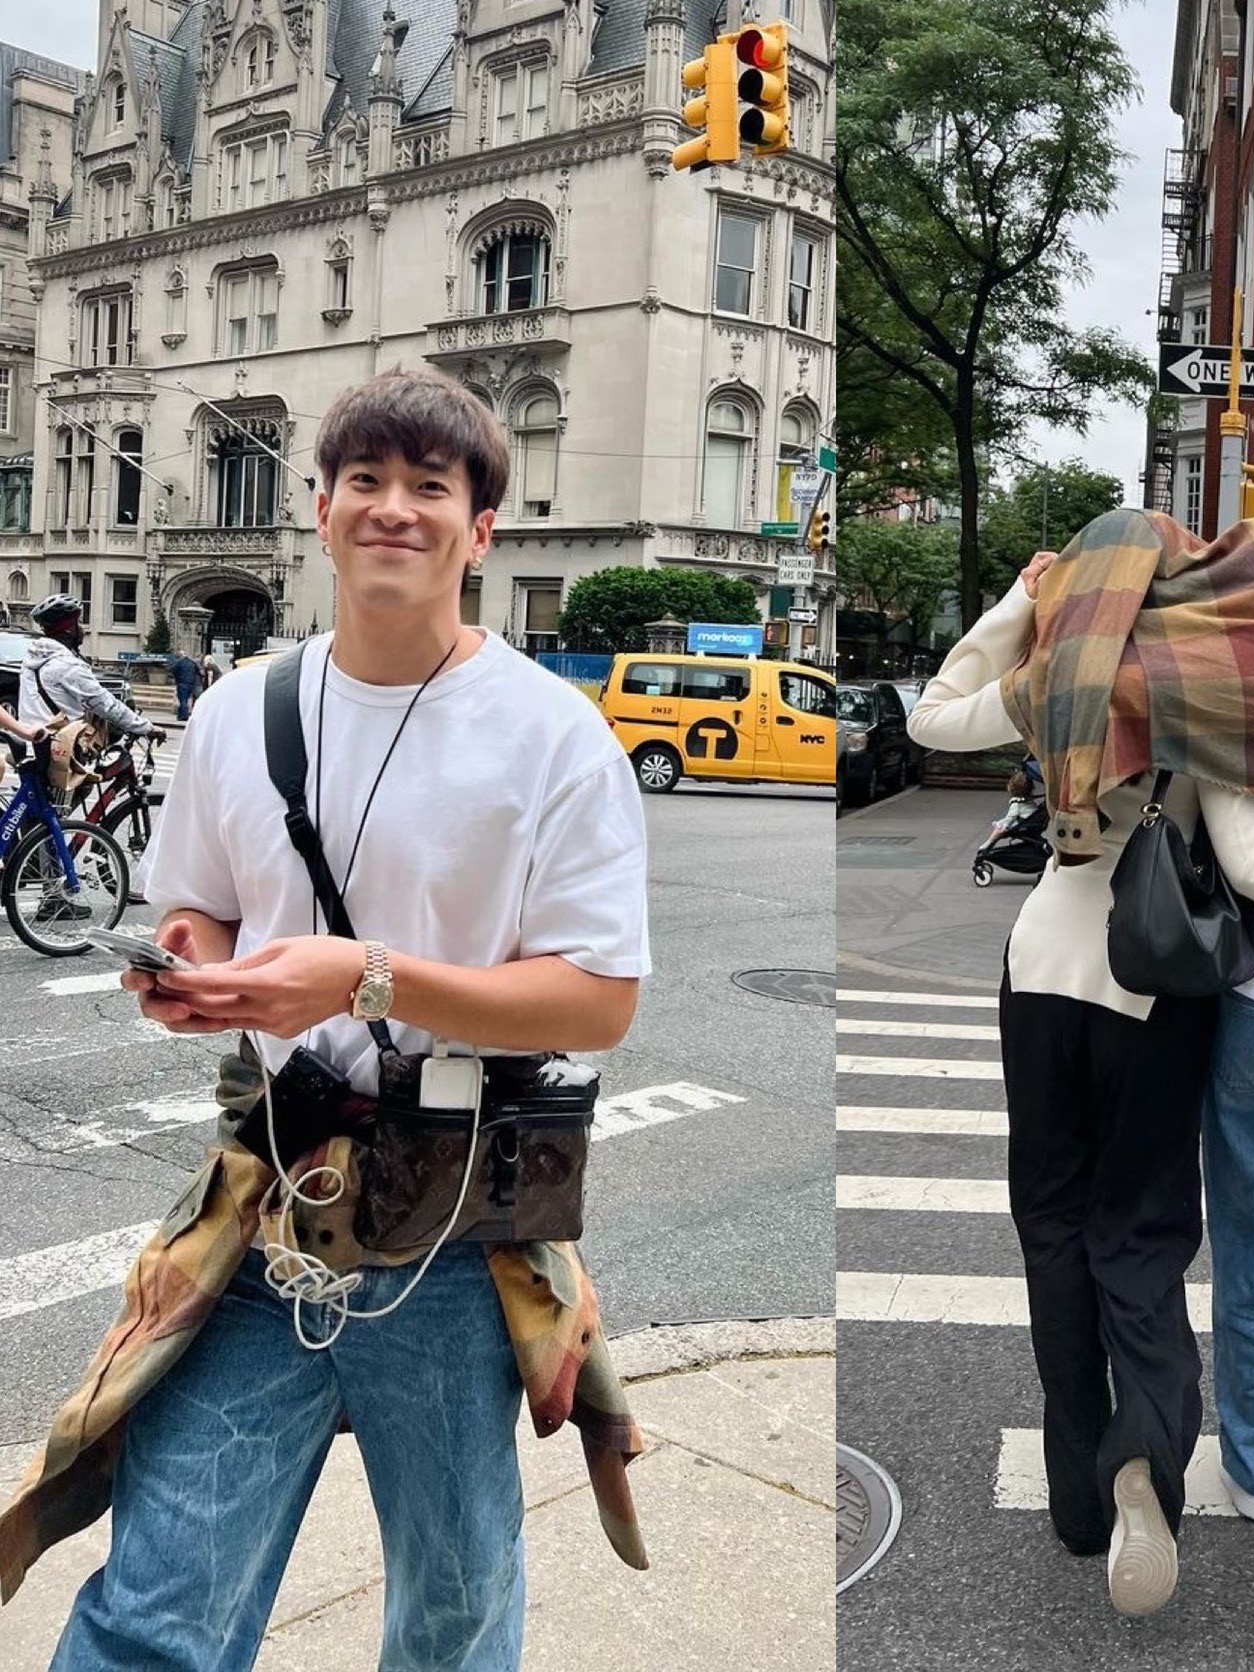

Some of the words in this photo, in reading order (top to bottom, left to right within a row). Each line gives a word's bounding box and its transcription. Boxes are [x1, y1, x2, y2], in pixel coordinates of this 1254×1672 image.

[1187, 361, 1231, 382] ONE
[781, 559, 812, 569] PASSENGER
[780, 571, 794, 580] CARS
[796, 571, 811, 580] ONLY
[697, 727, 728, 760] T
[800, 734, 825, 744] NYC
